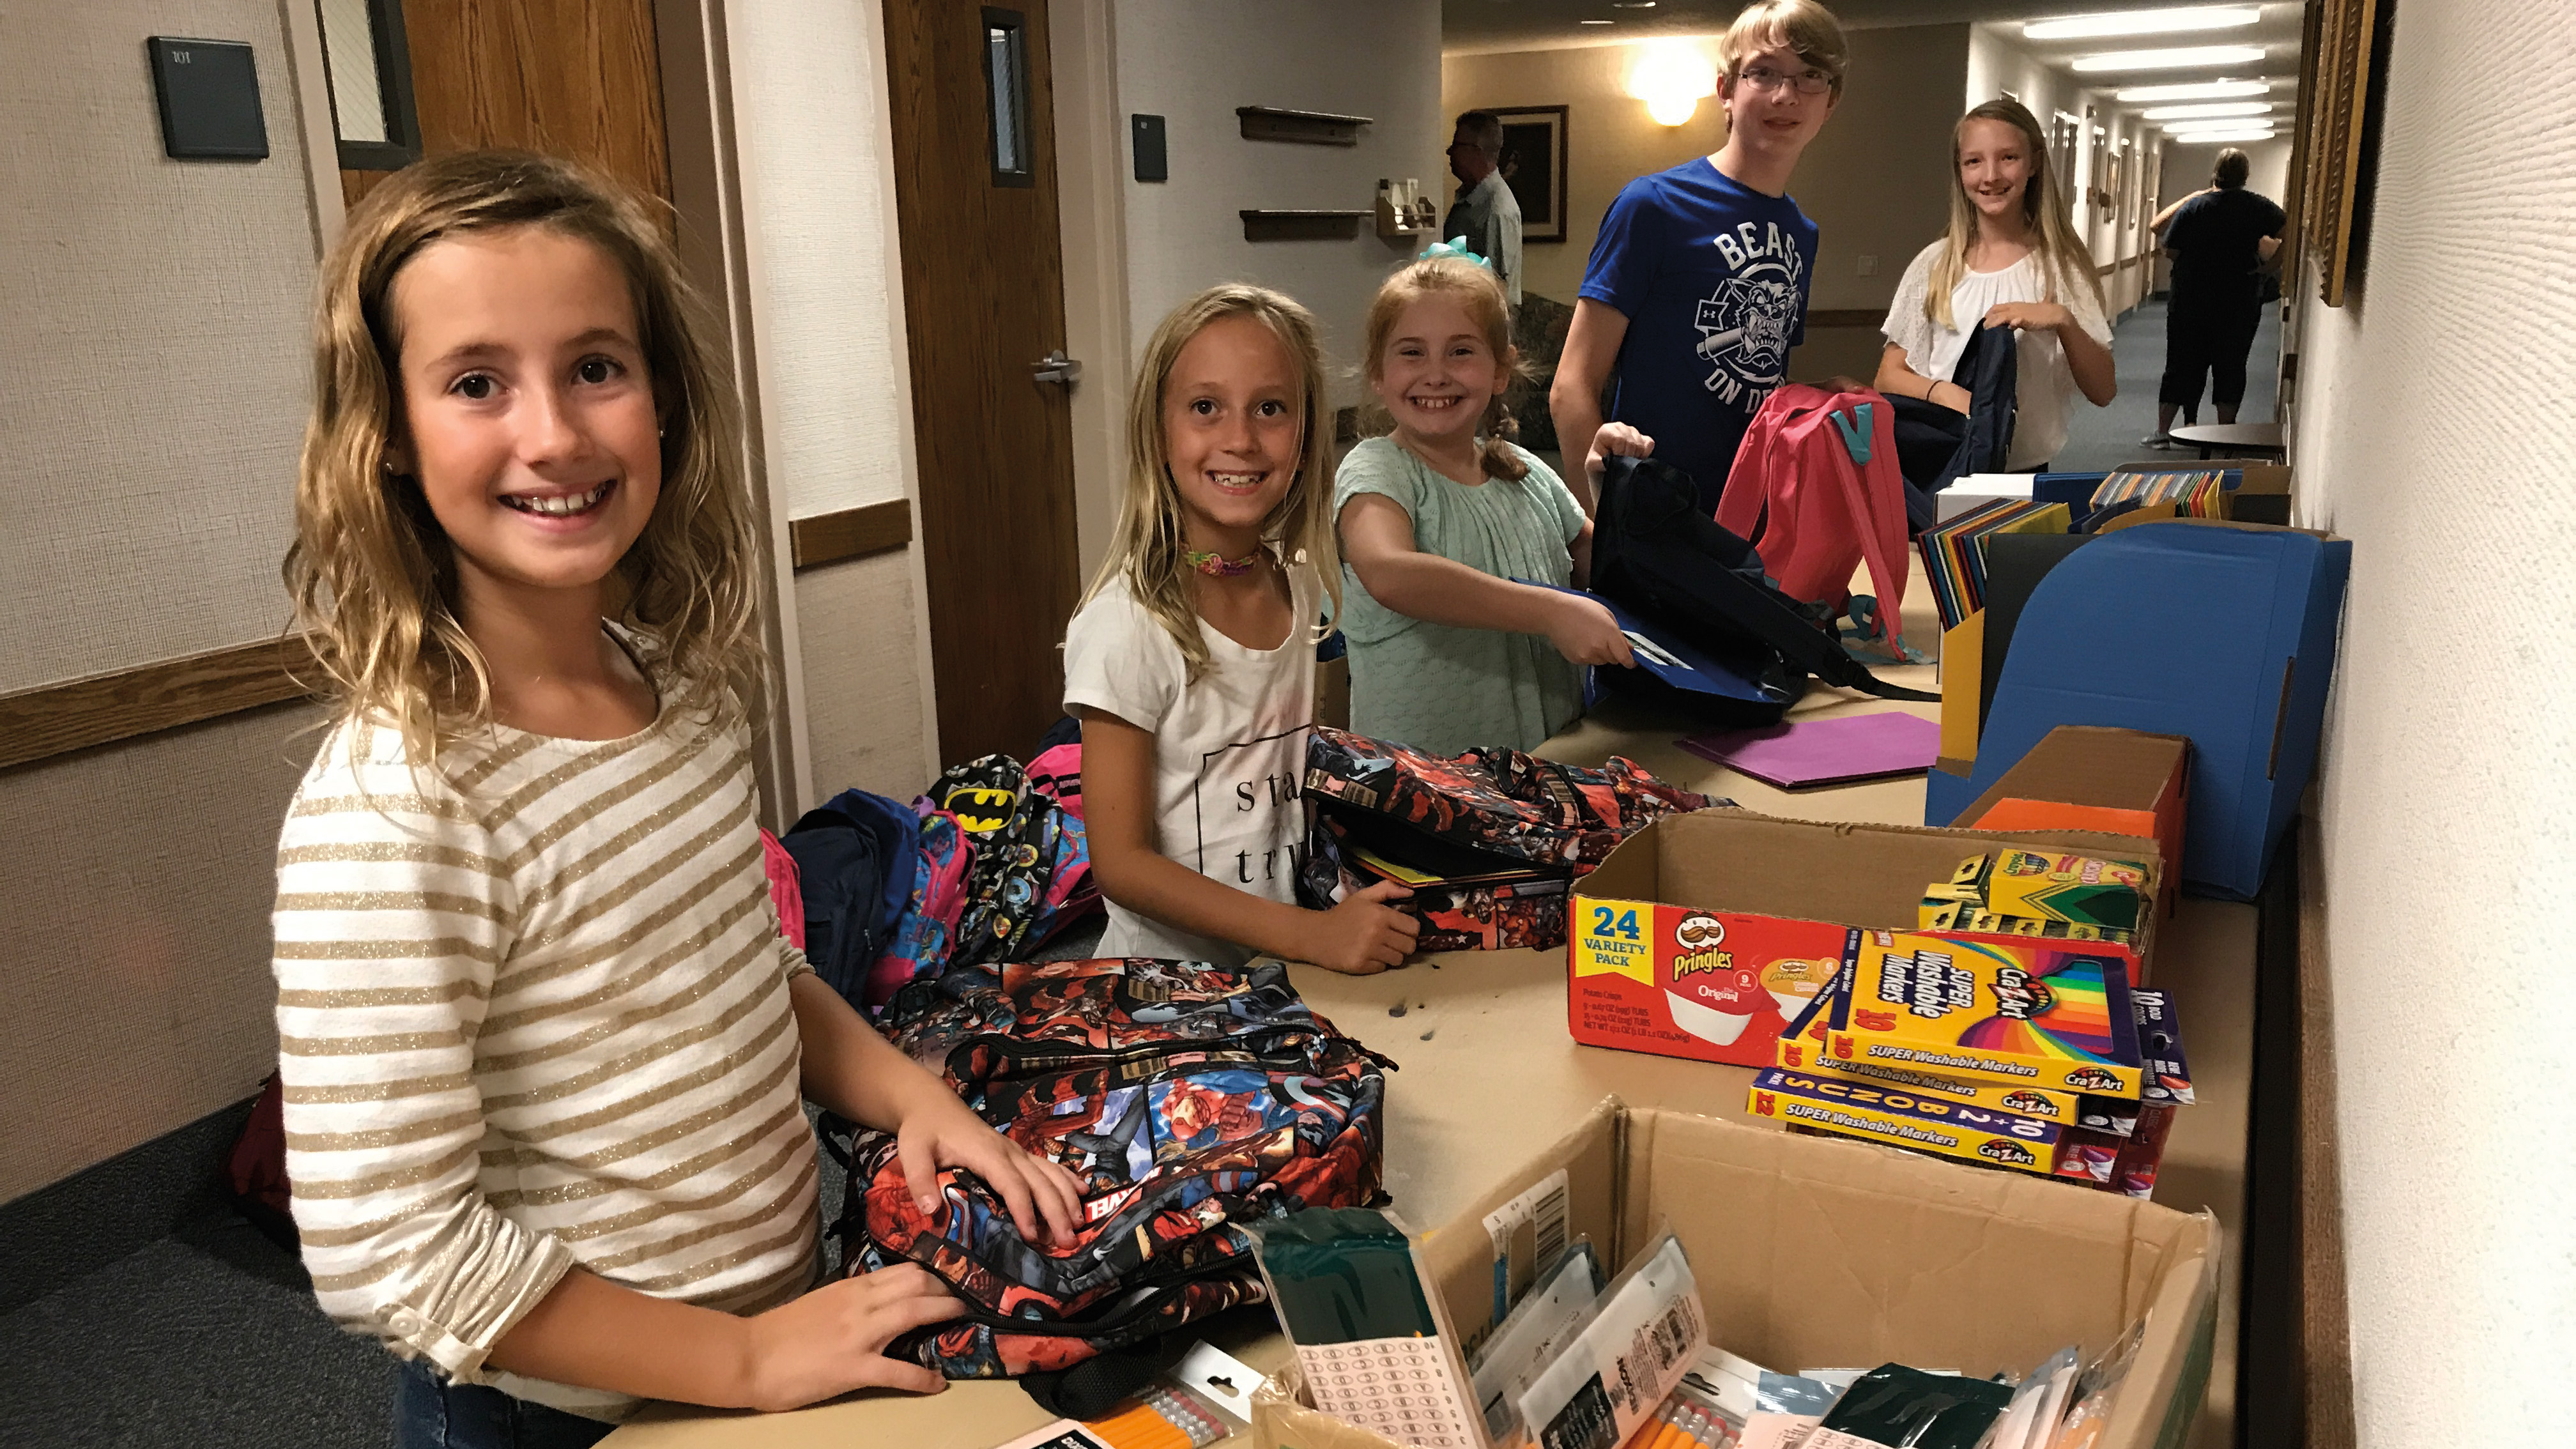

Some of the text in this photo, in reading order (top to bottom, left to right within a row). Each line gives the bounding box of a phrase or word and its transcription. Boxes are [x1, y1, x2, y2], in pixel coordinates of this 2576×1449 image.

[172, 51, 191, 64] 101
[1705, 368, 1742, 405] ON
[1593, 907, 1640, 940] 24
[1584, 939, 1646, 955] VARIETY
[1595, 953, 1630, 967] PACK
[1673, 947, 1733, 982] Pringles
[1741, 974, 1749, 983] 9
[1770, 972, 1813, 982] Pringles
[1882, 953, 1915, 1004] Markers
[1912, 949, 1952, 1018] Washable
[1948, 967, 1975, 1008] SUPER
[1698, 985, 1738, 1002] Original
[2131, 990, 2165, 1007] 10
[1854, 1008, 1896, 1032] 10
[1784, 1043, 1802, 1068] 10
[1834, 1034, 1855, 1059] 10
[1869, 1045, 2039, 1077] SUPER Washable Markers
[1816, 1054, 1977, 1098] SUPER Washable Markers
[1756, 1091, 1775, 1116] 12
[1958, 1108, 1991, 1124] 2
[1785, 1103, 1959, 1147] SUPER Washable Markers
[2010, 1117, 2046, 1137] 10
